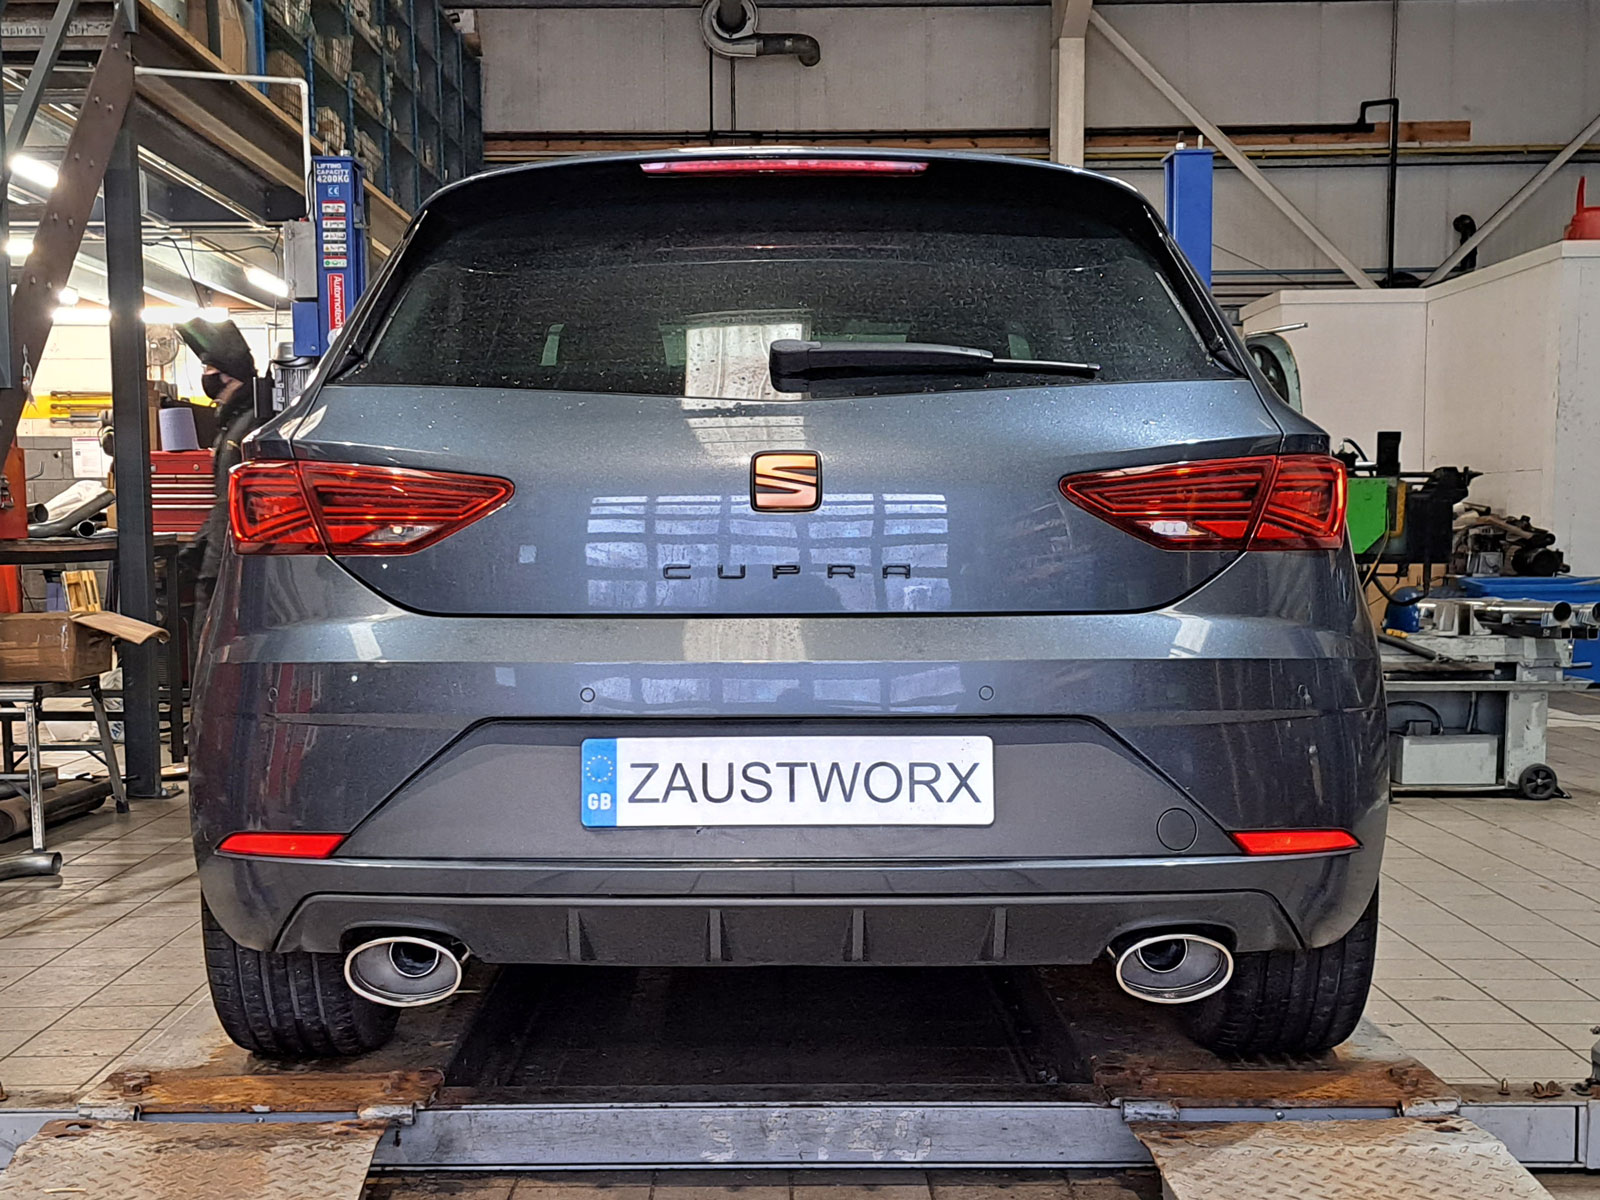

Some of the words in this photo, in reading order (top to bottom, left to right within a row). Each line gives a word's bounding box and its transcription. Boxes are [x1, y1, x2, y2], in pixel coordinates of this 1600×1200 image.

[316, 174, 350, 183] 4200KG
[333, 275, 344, 329] Automotech
[662, 564, 911, 580] CUPRA
[627, 761, 982, 804] ZAUSTWORX
[587, 792, 612, 811] GB
